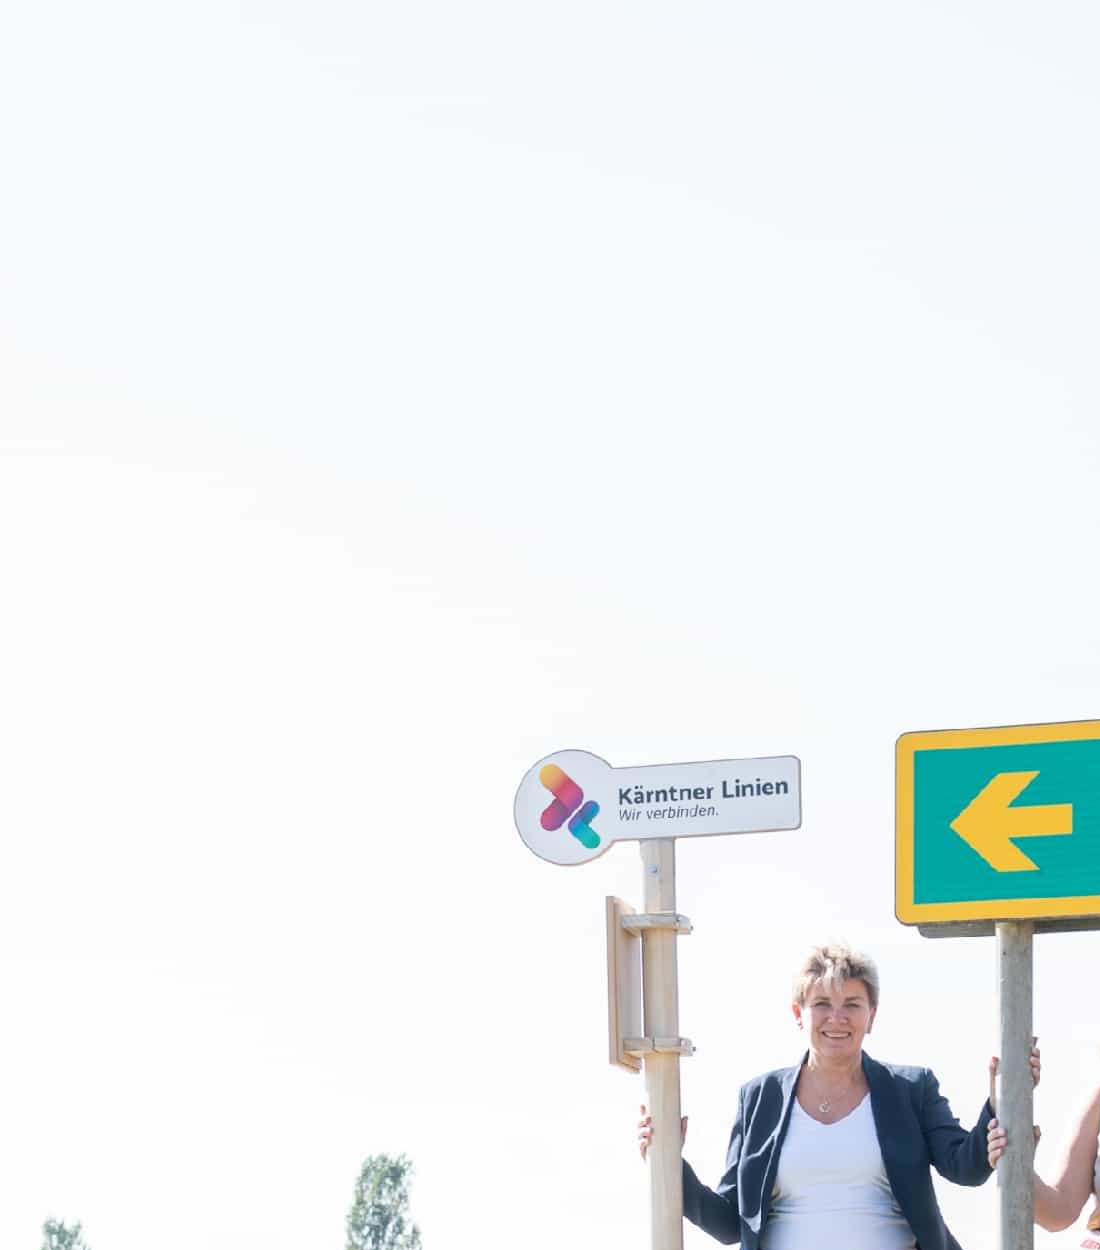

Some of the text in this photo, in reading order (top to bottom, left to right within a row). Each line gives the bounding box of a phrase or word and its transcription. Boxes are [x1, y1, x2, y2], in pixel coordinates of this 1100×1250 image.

[618, 778, 789, 806] Kärntner Linien
[619, 804, 719, 821] Wir verbinden.
